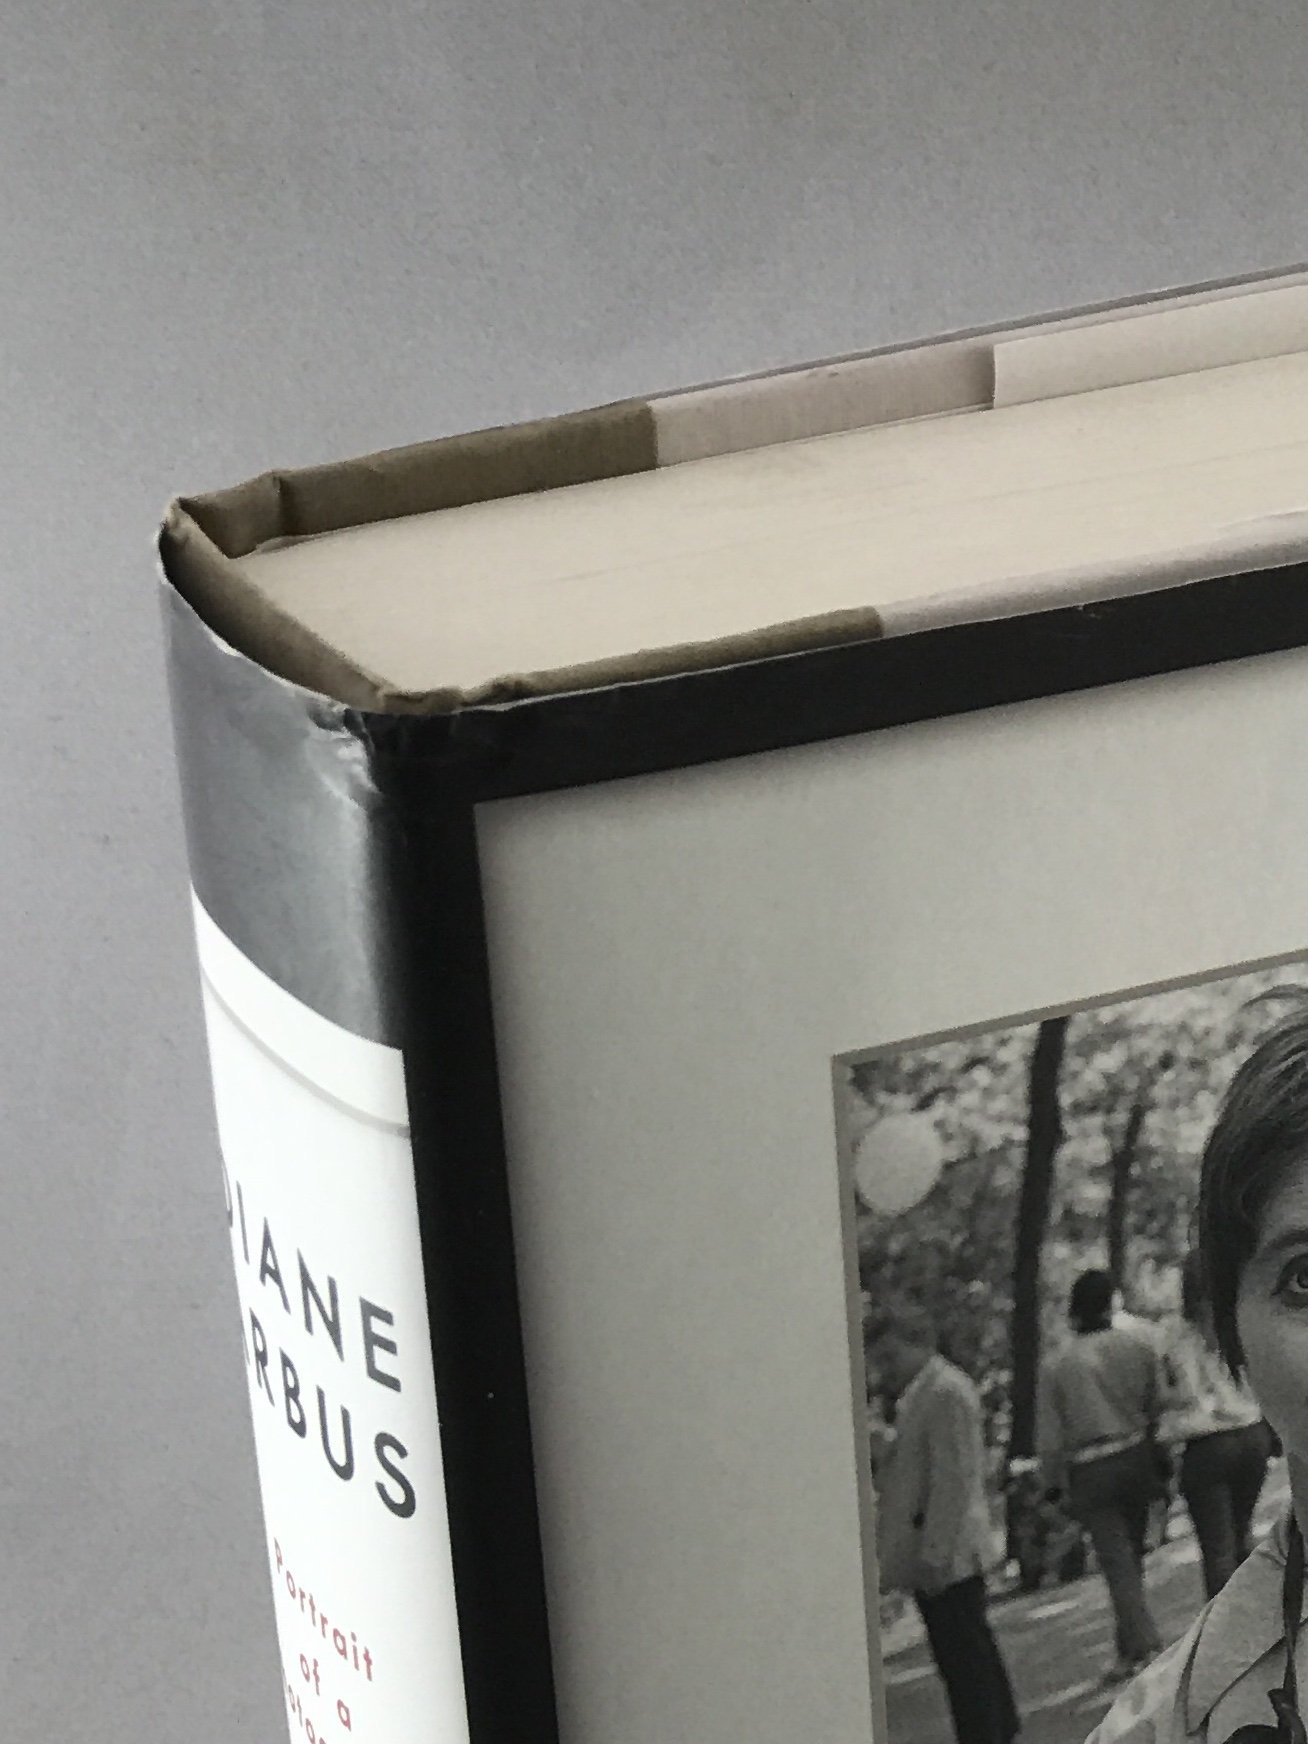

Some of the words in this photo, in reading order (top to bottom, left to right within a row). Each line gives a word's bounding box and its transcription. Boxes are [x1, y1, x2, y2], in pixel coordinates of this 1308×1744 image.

[242, 1307, 416, 1520] RBUS
[274, 1537, 372, 1682] Portrait
[299, 1653, 321, 1697] of
[336, 1698, 352, 1732] a
